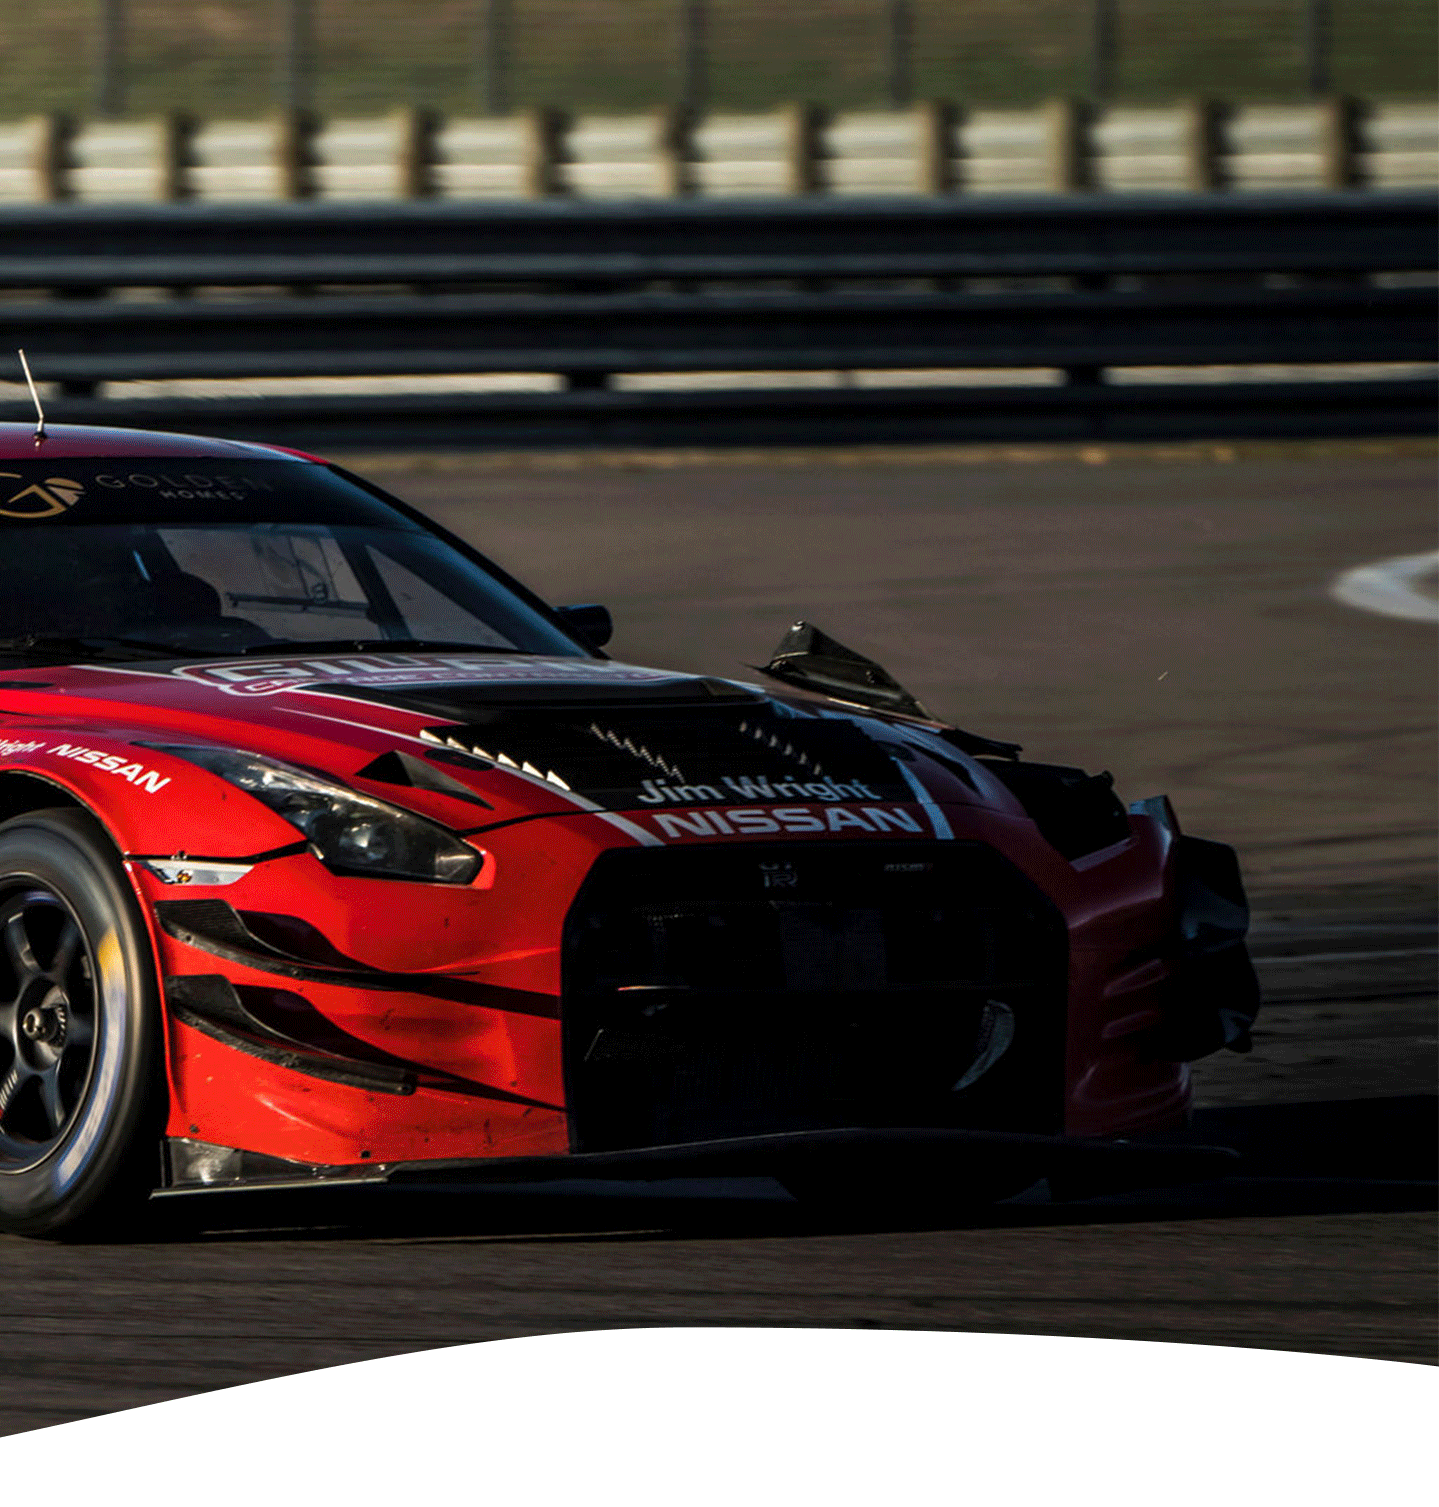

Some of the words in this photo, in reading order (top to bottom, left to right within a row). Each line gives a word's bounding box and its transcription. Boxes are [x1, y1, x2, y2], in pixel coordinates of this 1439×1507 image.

[95, 474, 274, 491] GOLDEN
[47, 743, 172, 794] NISSAN
[637, 778, 725, 803] Jim
[721, 775, 882, 801] Wright
[652, 807, 924, 838] NISSAN
